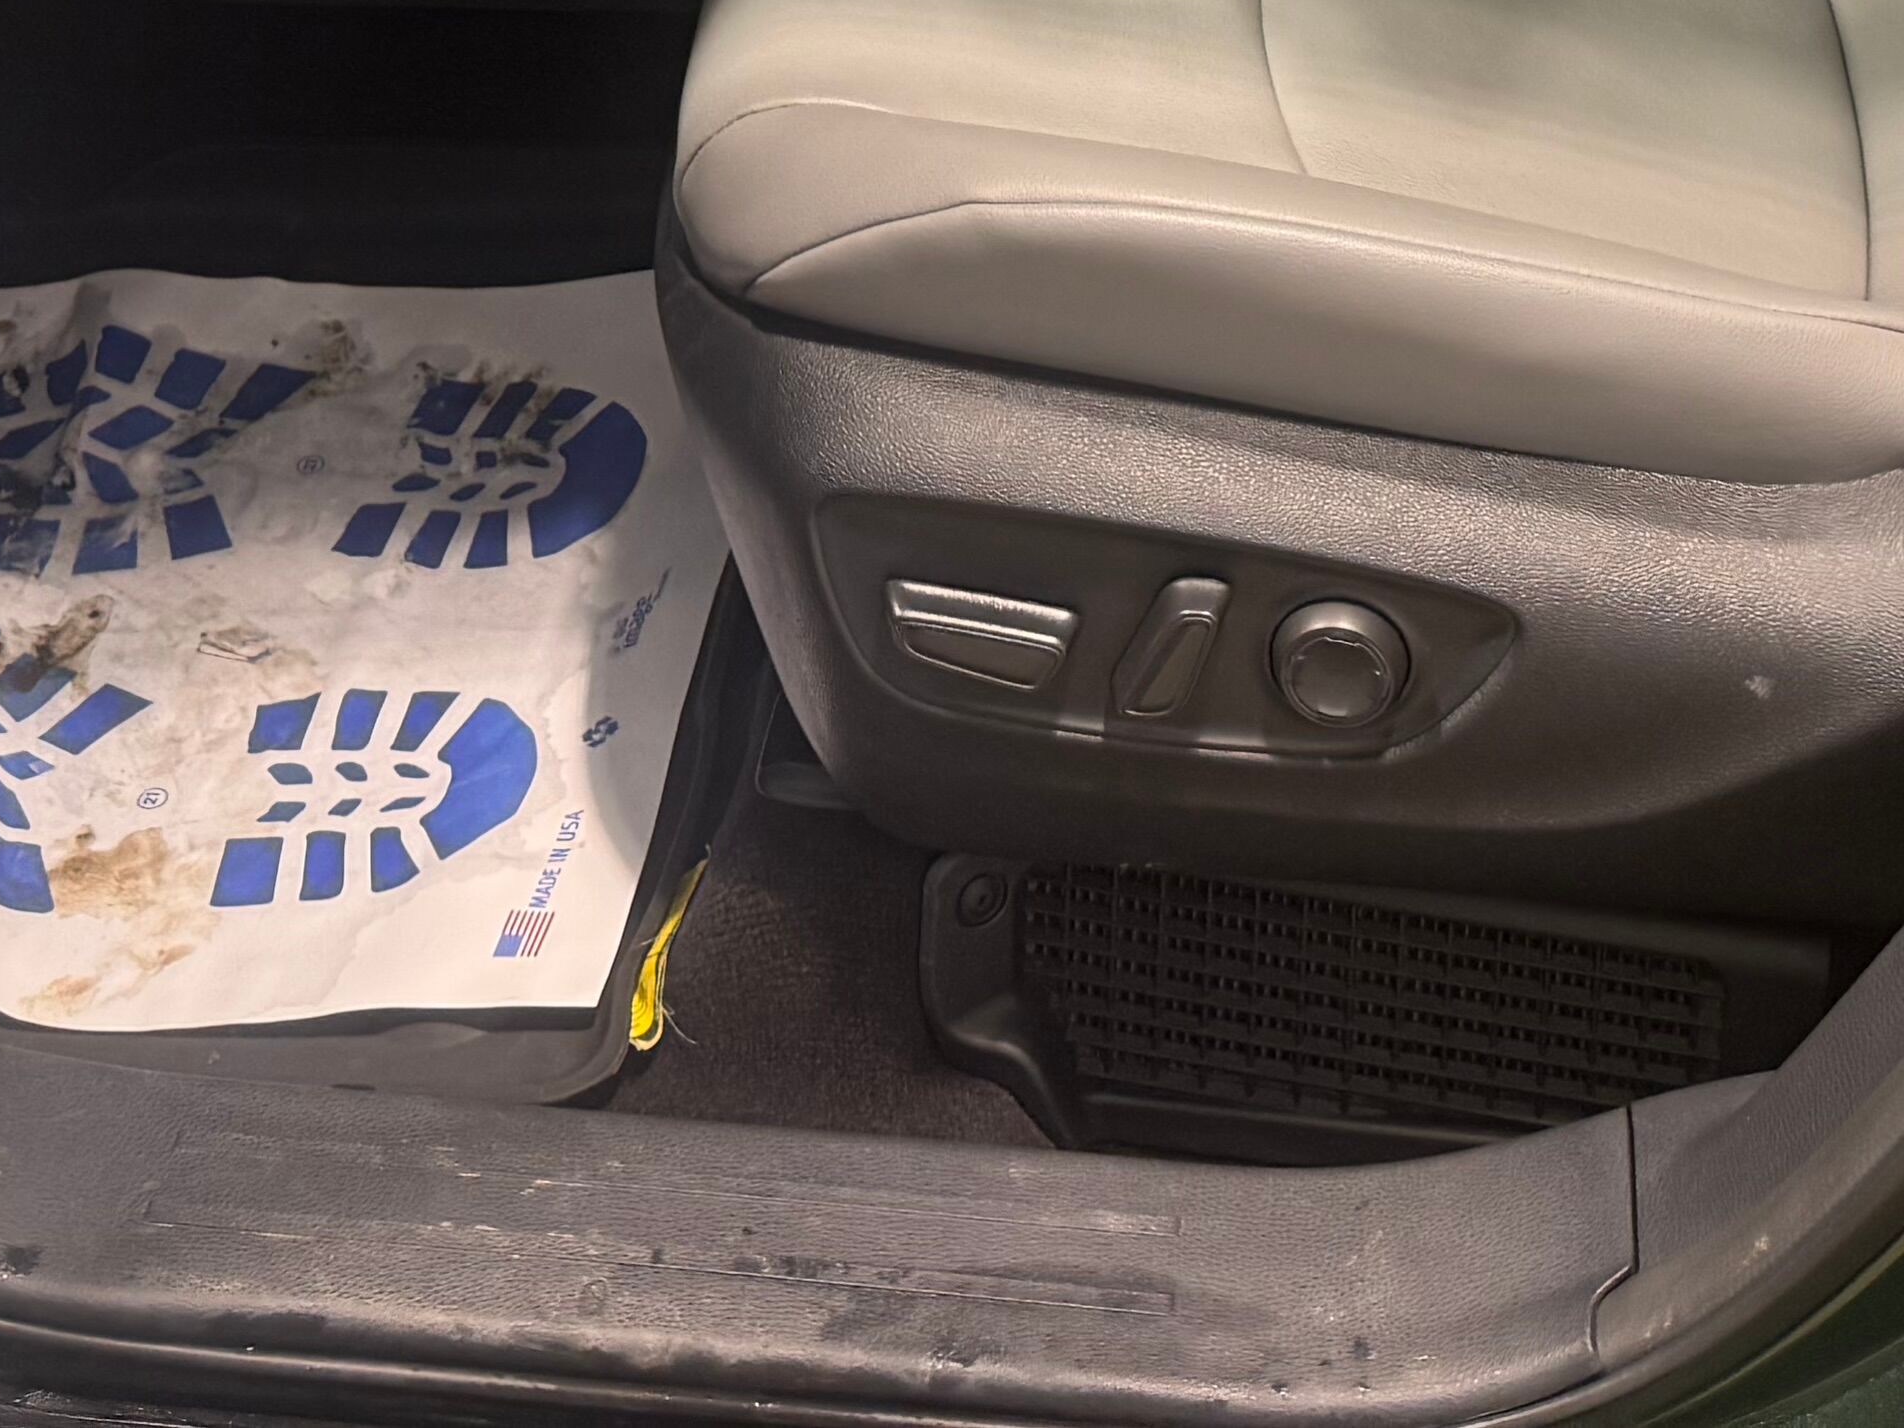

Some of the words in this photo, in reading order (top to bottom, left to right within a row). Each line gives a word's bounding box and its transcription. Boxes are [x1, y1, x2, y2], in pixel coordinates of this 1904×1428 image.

[556, 810, 584, 840] USA
[548, 848, 570, 861] IN
[528, 868, 560, 908] MADE
